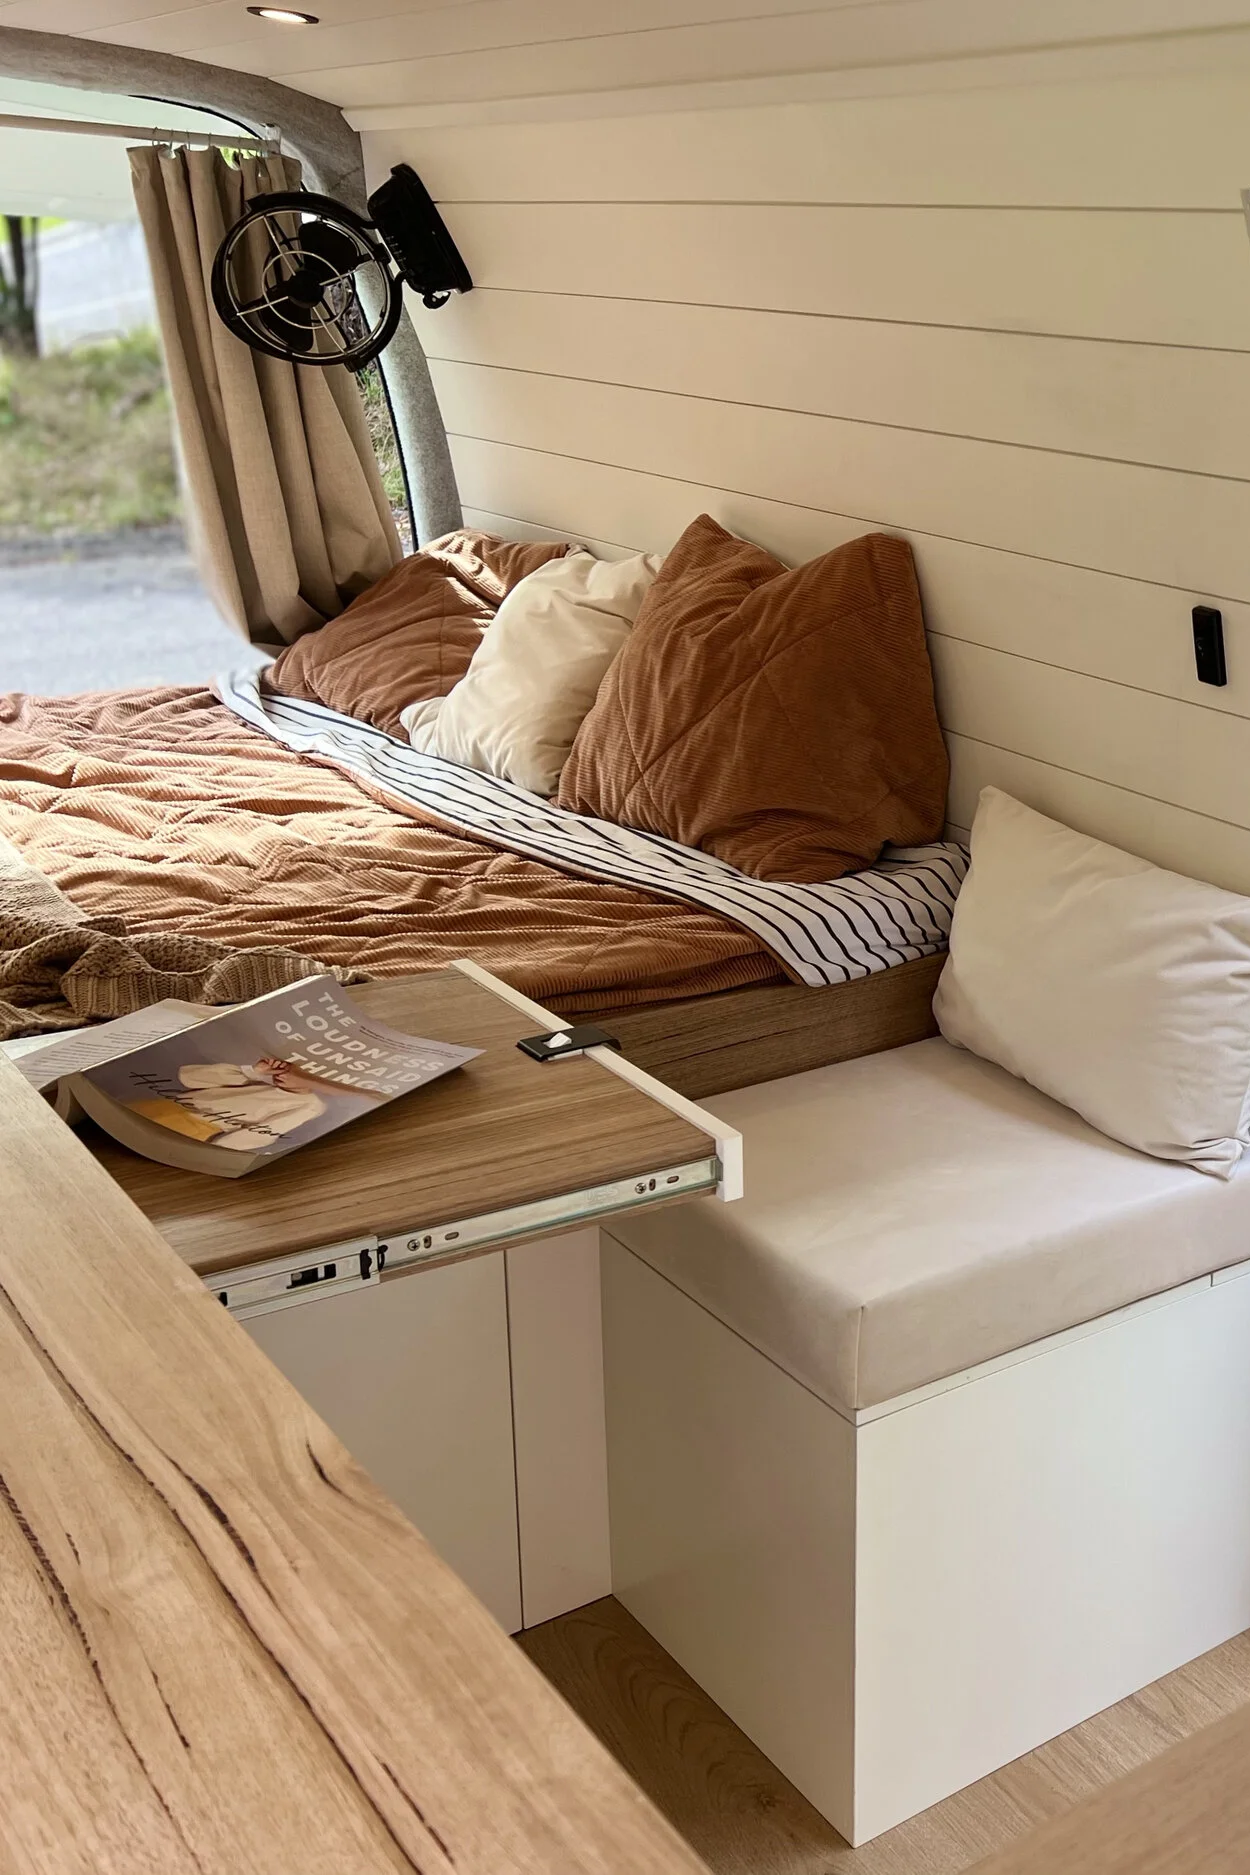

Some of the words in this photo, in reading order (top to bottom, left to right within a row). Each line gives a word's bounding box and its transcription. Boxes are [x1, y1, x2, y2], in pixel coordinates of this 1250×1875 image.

[318, 992, 357, 1027] THE
[275, 1020, 306, 1042] OF
[306, 1042, 422, 1083] UNSAID
[291, 1000, 445, 1072] LOUDNESS
[285, 1052, 400, 1094] THINGS
